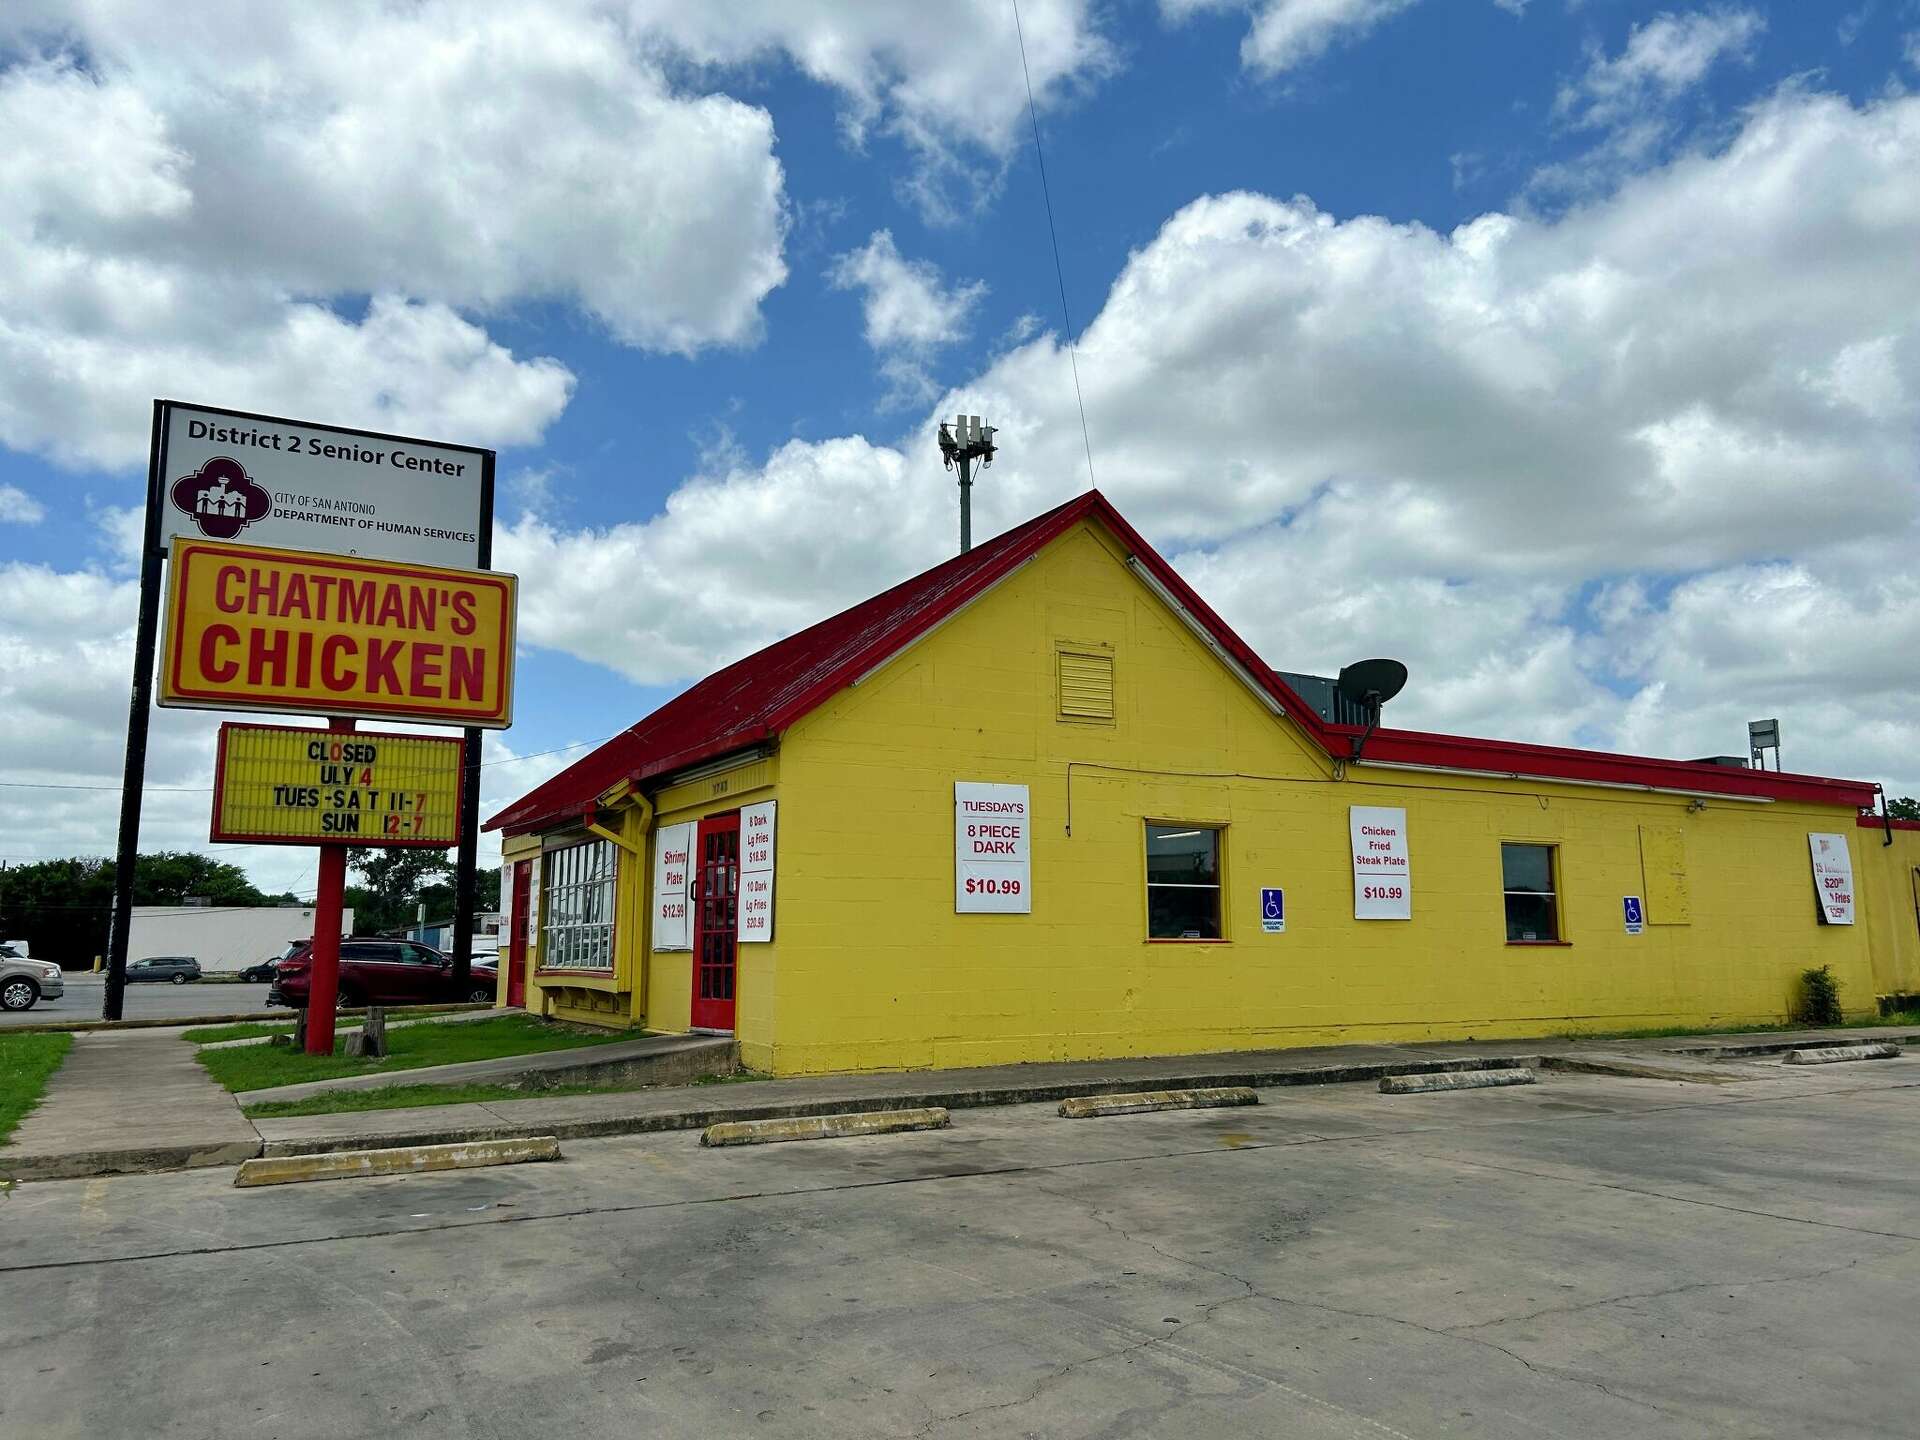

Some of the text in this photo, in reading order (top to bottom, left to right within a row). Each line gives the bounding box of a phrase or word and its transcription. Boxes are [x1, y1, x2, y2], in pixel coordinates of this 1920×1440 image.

[189, 420, 465, 477] District 2 Senior Center
[274, 492, 376, 515] CITY OF SAN ANTONIO
[274, 508, 476, 543] DEPARTMENT OF HUMAN SERVICES
[215, 565, 477, 636] CHATMAN'S
[200, 623, 486, 702] CHICKEN
[307, 741, 377, 764] CLOSED
[320, 766, 372, 786] ULY 4
[390, 792, 426, 812] 11-7
[963, 800, 1024, 814] TUESDAY'S
[322, 813, 424, 834] SUN 12-7
[754, 814, 767, 826] Dark
[967, 824, 1021, 839] 8 PIECE
[1361, 826, 1396, 837] Chicken
[747, 832, 769, 847] Lg Fries
[1369, 841, 1391, 851] Fried
[974, 841, 1016, 854] DARK
[664, 850, 686, 866] Shrimp
[1356, 855, 1406, 866] Steak Plate
[666, 872, 683, 886] Plate
[754, 880, 767, 892] Dark
[966, 878, 1021, 895] $10.99
[1364, 886, 1402, 899] $10.99
[1834, 892, 1851, 904] Fries
[662, 903, 684, 919] $12.99
[753, 899, 767, 910] Fries
